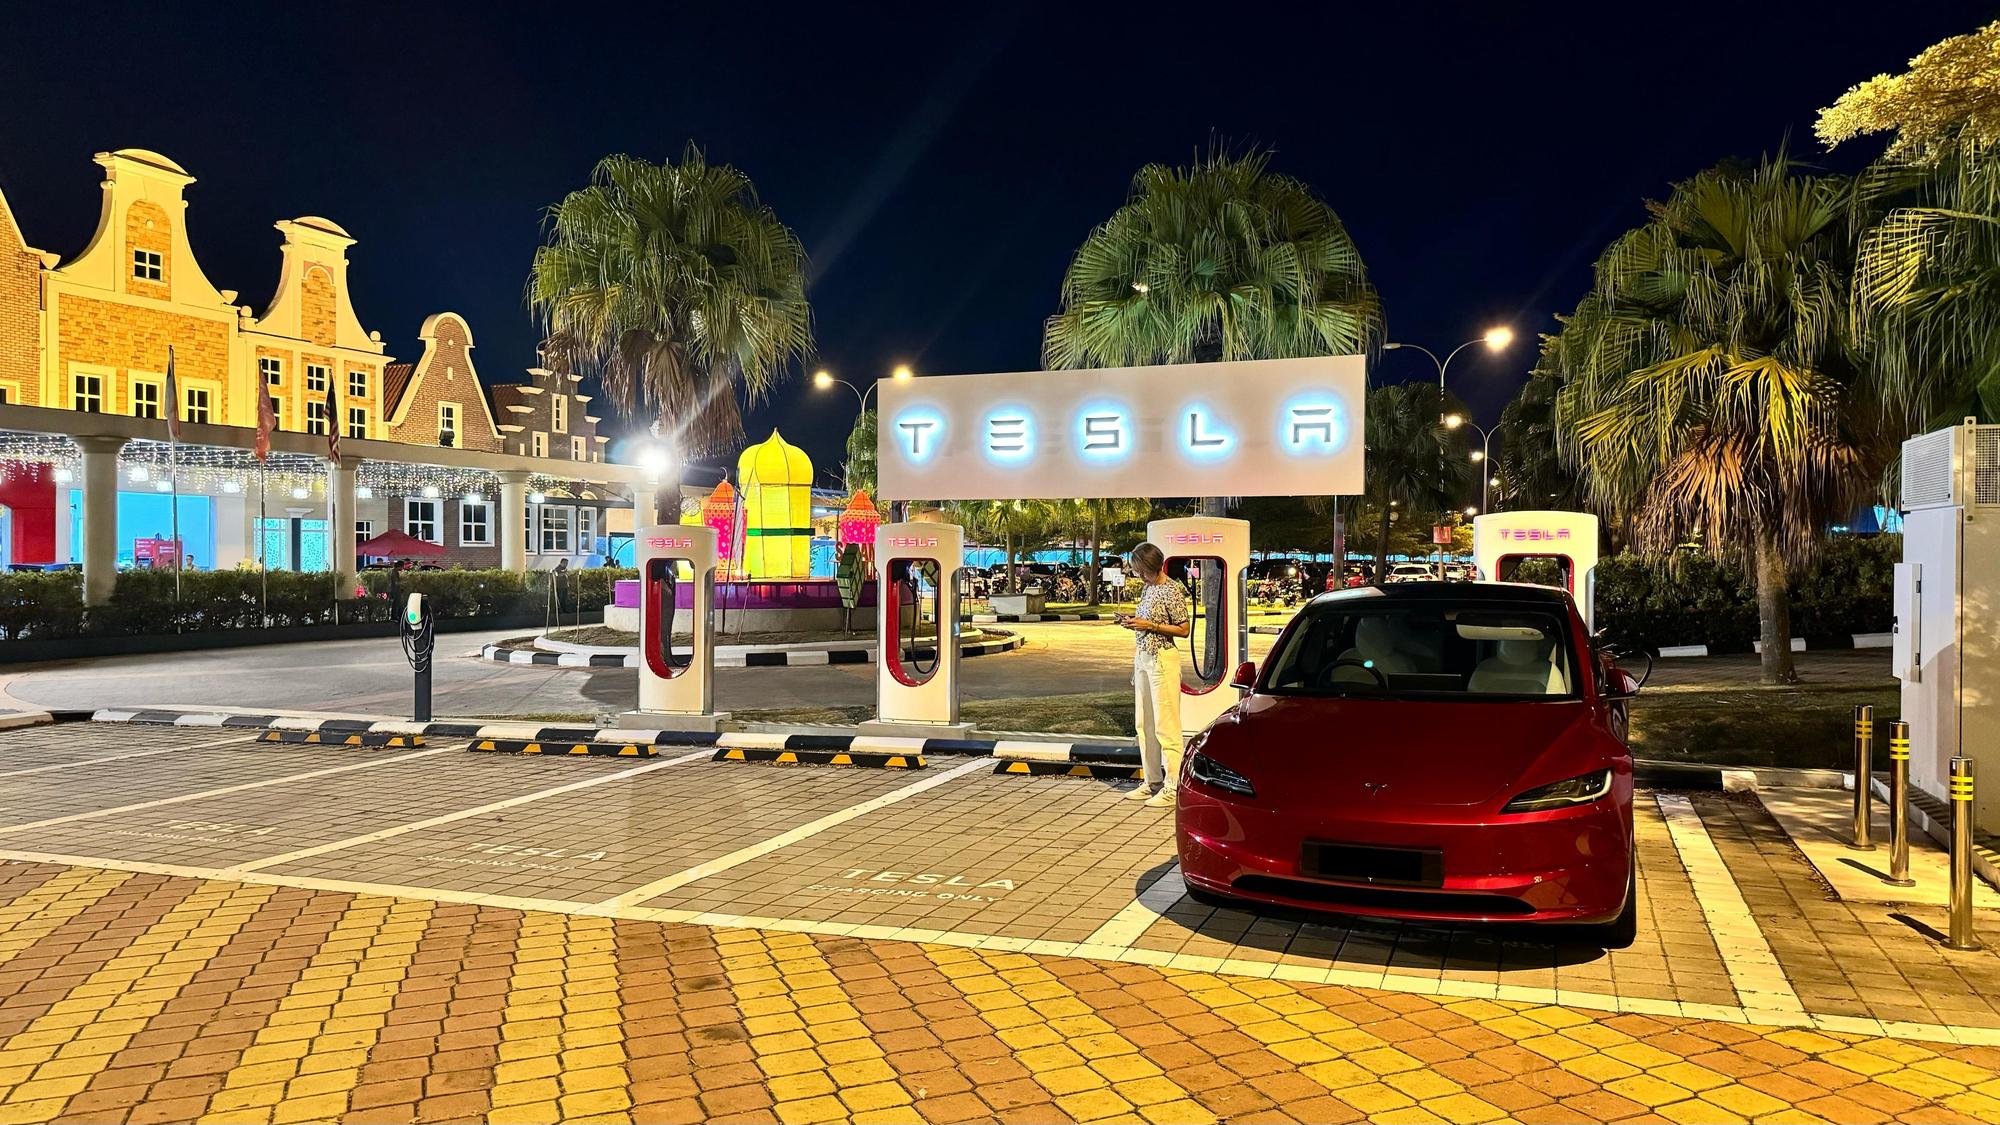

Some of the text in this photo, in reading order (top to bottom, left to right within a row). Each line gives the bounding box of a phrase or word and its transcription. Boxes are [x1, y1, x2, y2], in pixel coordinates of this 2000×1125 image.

[899, 407, 1332, 454] TESLA
[1165, 533, 1224, 544] TESLA
[1499, 527, 1570, 540] TESLA
[647, 538, 693, 548] TESLA
[888, 537, 938, 547] TESLA
[152, 819, 278, 835] TESLA
[466, 843, 607, 861] TESLA
[843, 868, 1015, 890] TESLA
[807, 884, 1003, 903] CHARGING ONLY
